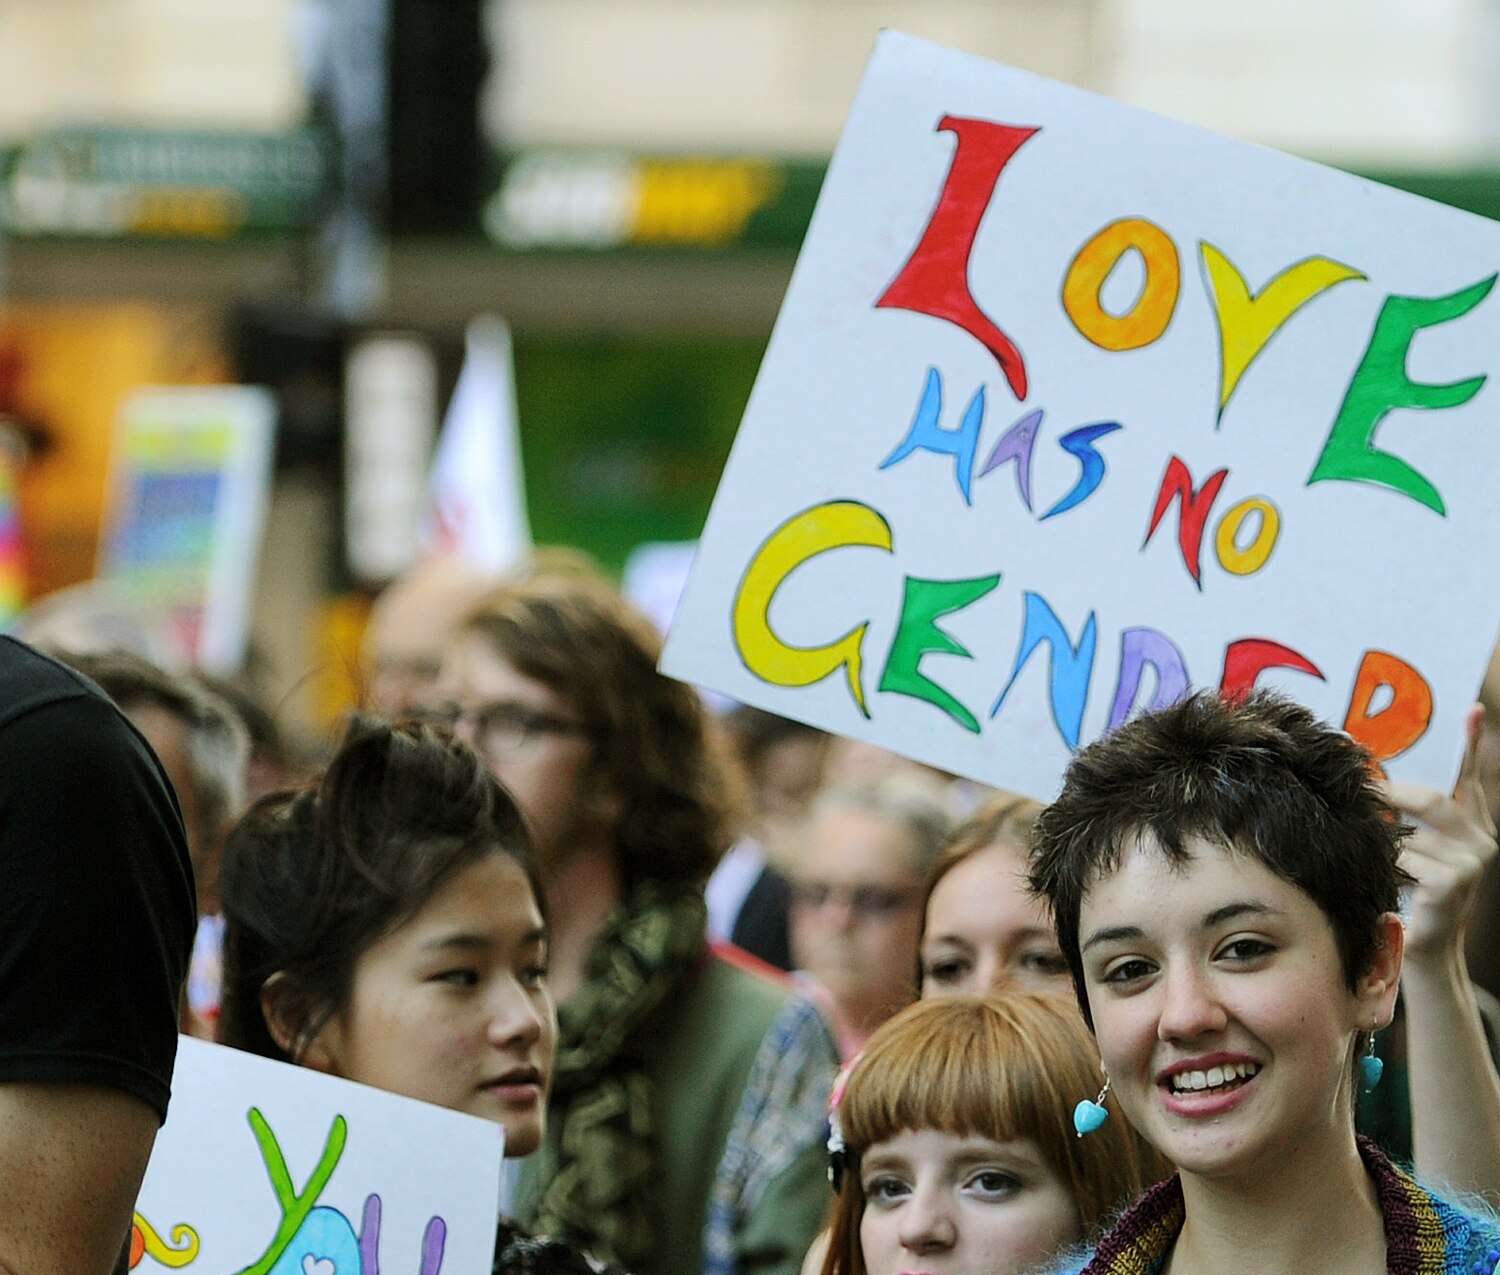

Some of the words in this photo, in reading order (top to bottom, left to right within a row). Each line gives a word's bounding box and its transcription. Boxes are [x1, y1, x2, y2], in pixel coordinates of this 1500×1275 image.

[873, 112, 1500, 519] LOVE
[878, 366, 1125, 522] HAS
[1141, 454, 1282, 593] NO
